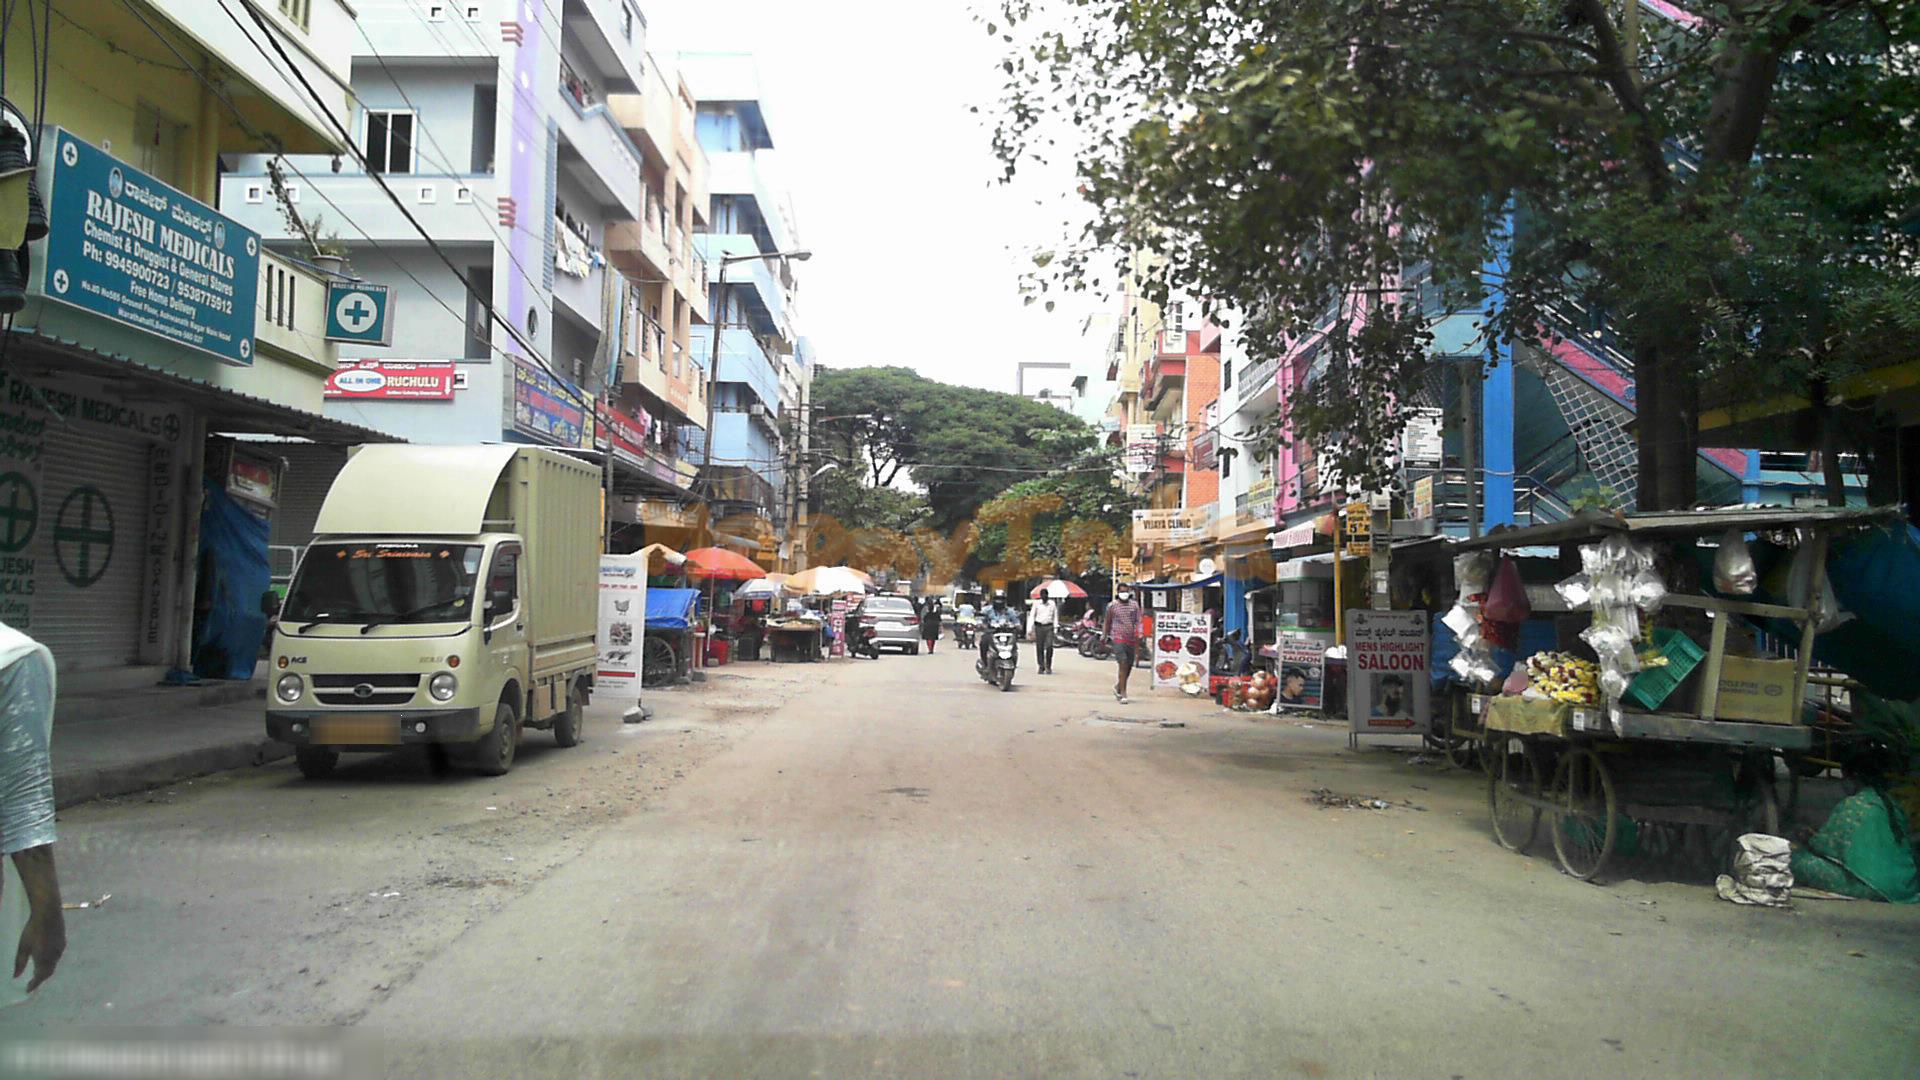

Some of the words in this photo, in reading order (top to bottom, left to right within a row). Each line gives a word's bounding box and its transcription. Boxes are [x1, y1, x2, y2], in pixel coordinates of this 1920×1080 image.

[87, 190, 155, 245] RAJESH
[160, 223, 234, 278] MEDICALS
[84, 219, 123, 249] Chemist
[124, 238, 131, 252] &
[133, 243, 170, 272] Druggist
[171, 259, 177, 272] &
[178, 262, 208, 287] General
[210, 277, 232, 296] Stores
[84, 243, 103, 263] Ph:
[105, 252, 170, 289] 9945900723
[177, 281, 232, 314] 9538775912
[130, 281, 148, 298] Free
[148, 289, 169, 306] Home
[169, 296, 196, 319] Delivery
[387, 376, 439, 388] RUCHULU
[1143, 519, 1166, 529] VIJAYA
[1167, 518, 1191, 529] CLINIC
[1355, 642, 1378, 652] MENS
[1380, 642, 1424, 652] HIGHLIGHT
[291, 656, 308, 664] ACE
[1358, 653, 1424, 671] SALOON
